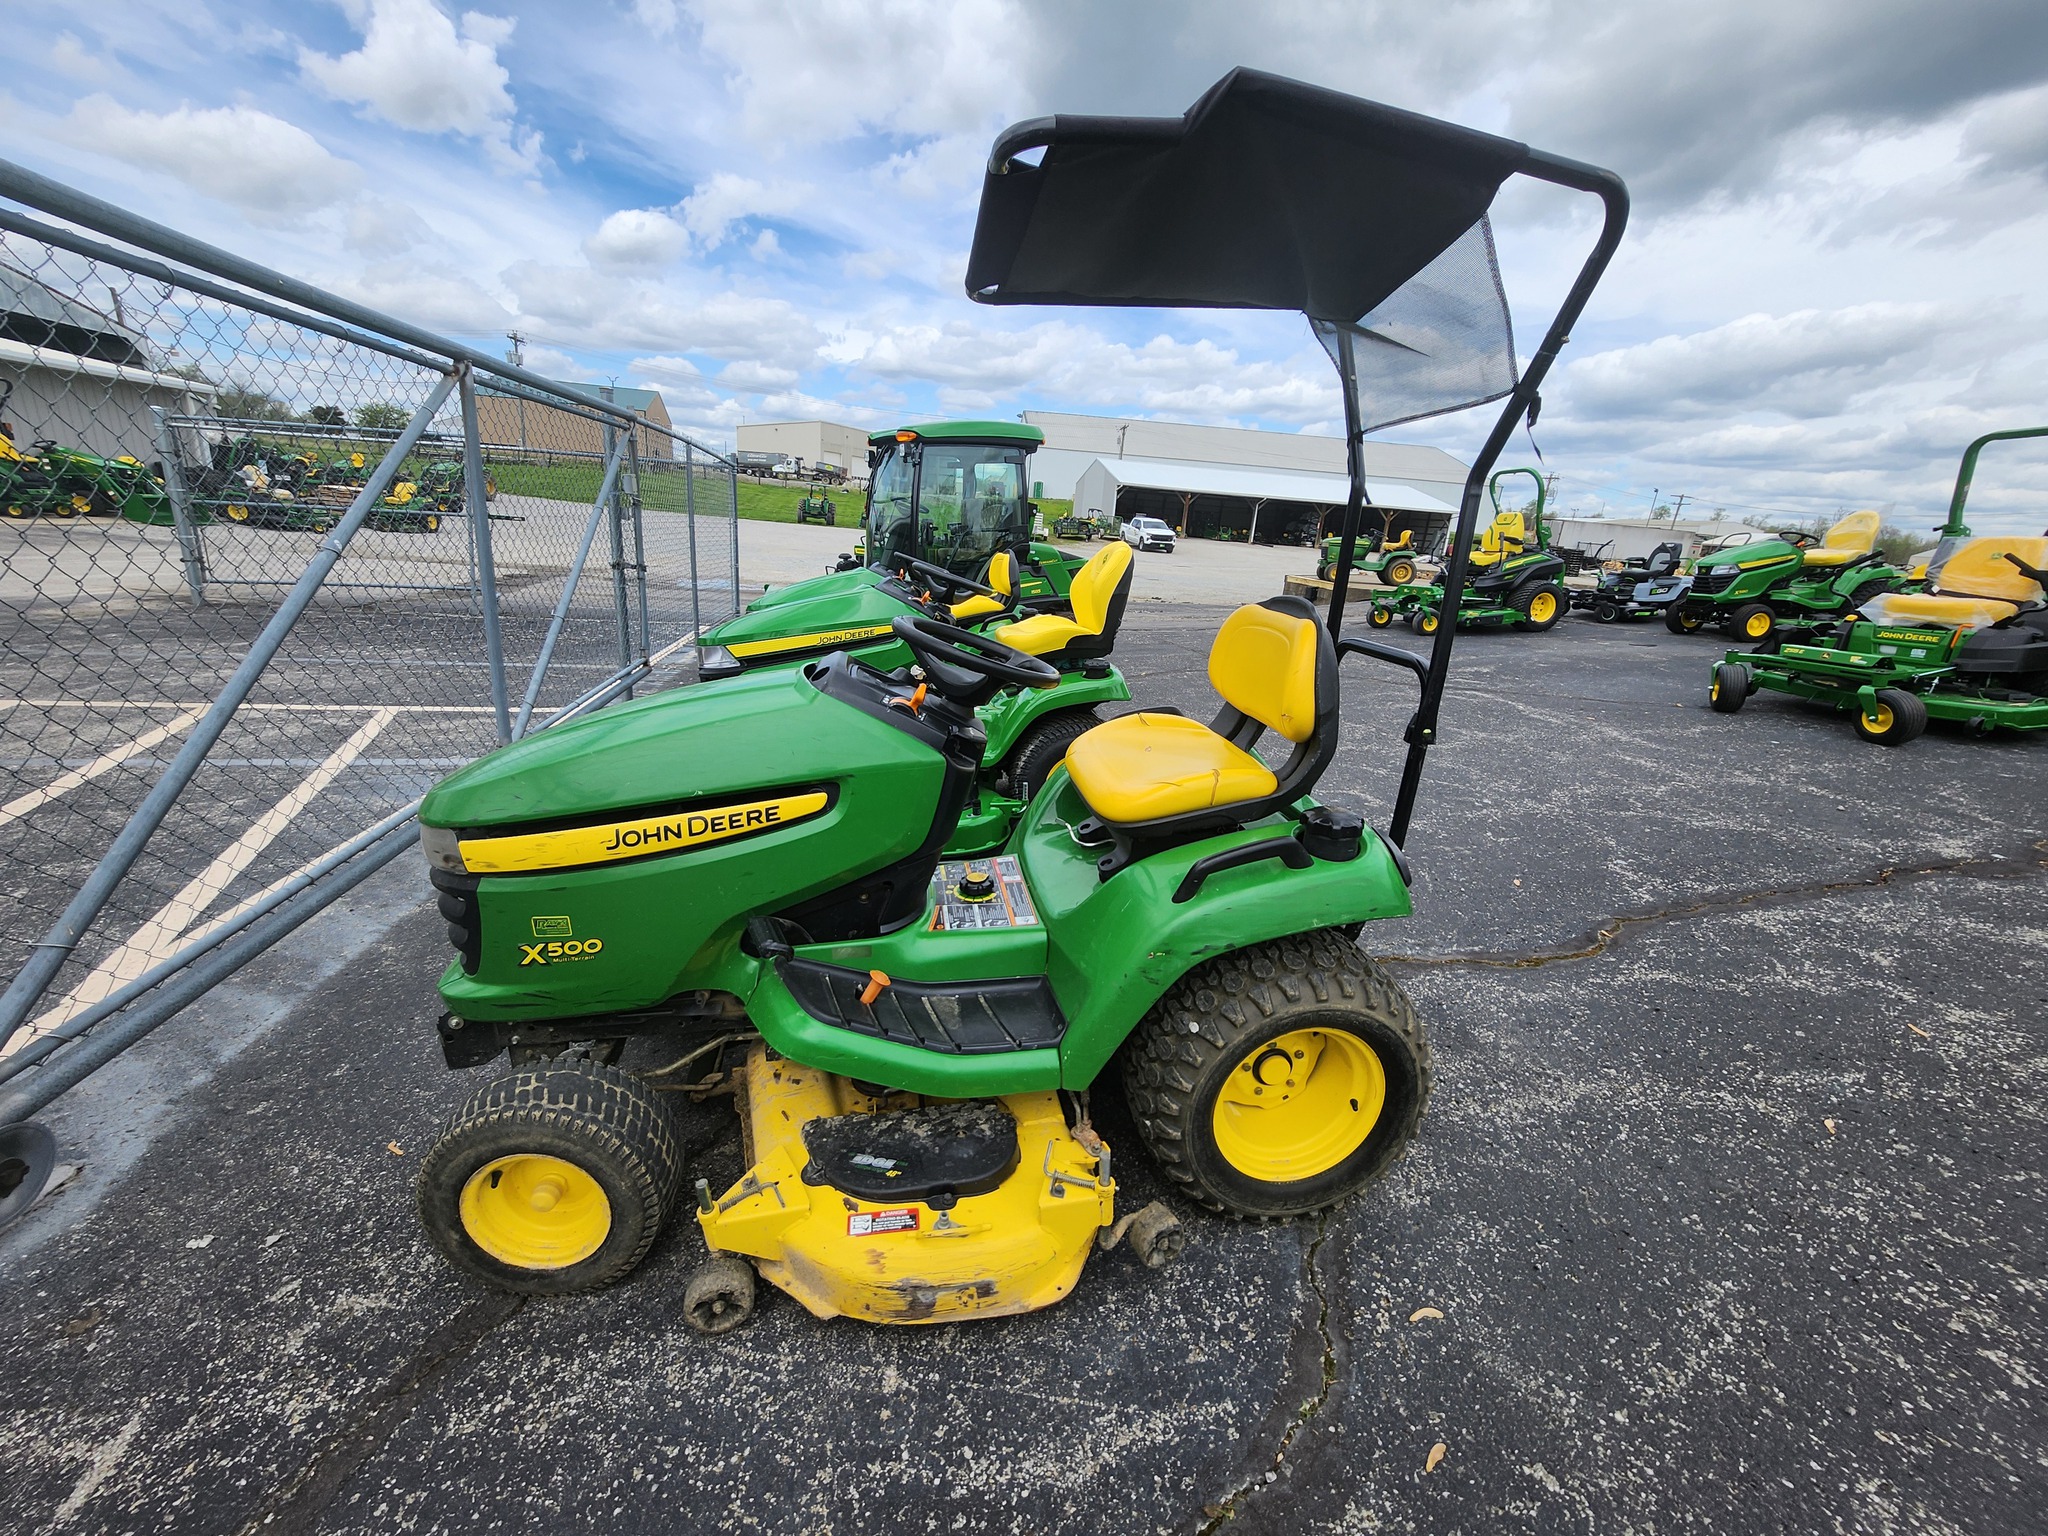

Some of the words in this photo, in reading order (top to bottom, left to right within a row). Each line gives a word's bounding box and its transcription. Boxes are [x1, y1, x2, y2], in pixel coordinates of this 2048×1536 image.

[1651, 587, 1669, 595] EGO
[816, 634, 843, 646] JOHN
[844, 629, 876, 641] DEERE
[1876, 631, 1904, 639] JOHN
[1904, 633, 1940, 643] DEERE
[606, 824, 683, 851] JOHN
[688, 805, 781, 836] DEERE
[519, 938, 603, 965] X500
[849, 1153, 898, 1170] EDGE
